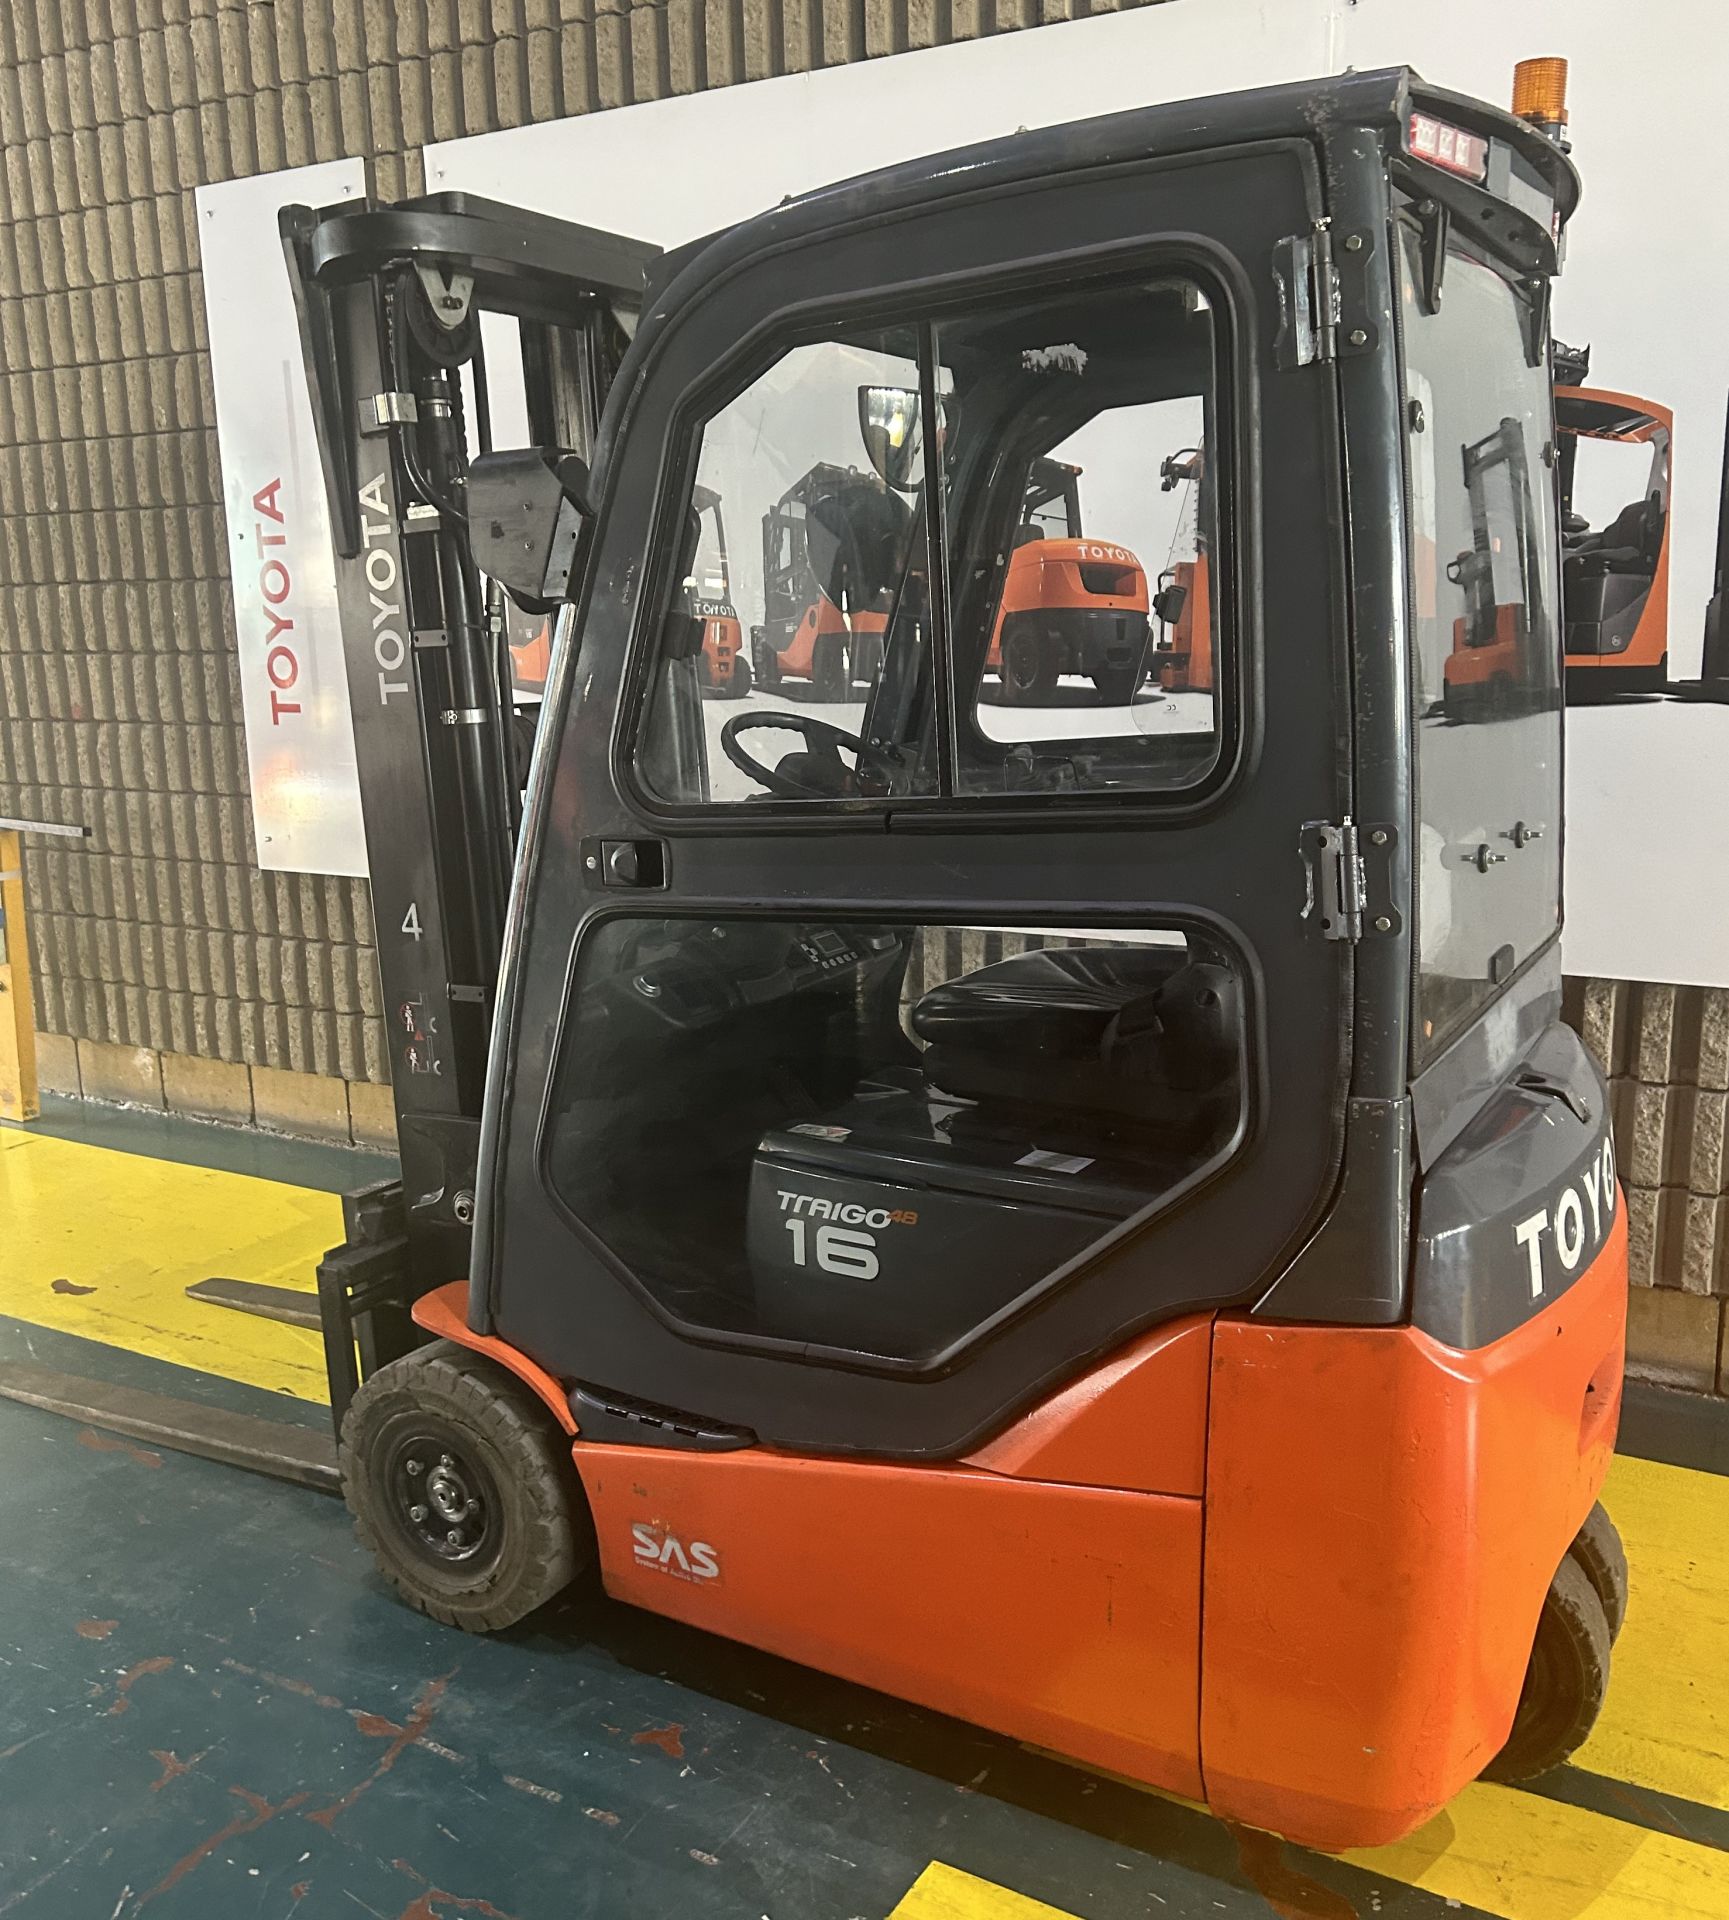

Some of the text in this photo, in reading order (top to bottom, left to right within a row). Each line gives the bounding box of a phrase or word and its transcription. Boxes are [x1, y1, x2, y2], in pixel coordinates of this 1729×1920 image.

[1077, 543, 1140, 566] TOYOTA
[252, 477, 301, 726] TOYOTA
[358, 472, 409, 705] TOYOTA
[401, 902, 423, 942] 4
[777, 1190, 891, 1229] TRAIGO
[1515, 1123, 1616, 1299] TOYO
[785, 1218, 879, 1280] 16
[632, 1523, 719, 1578] SAS
